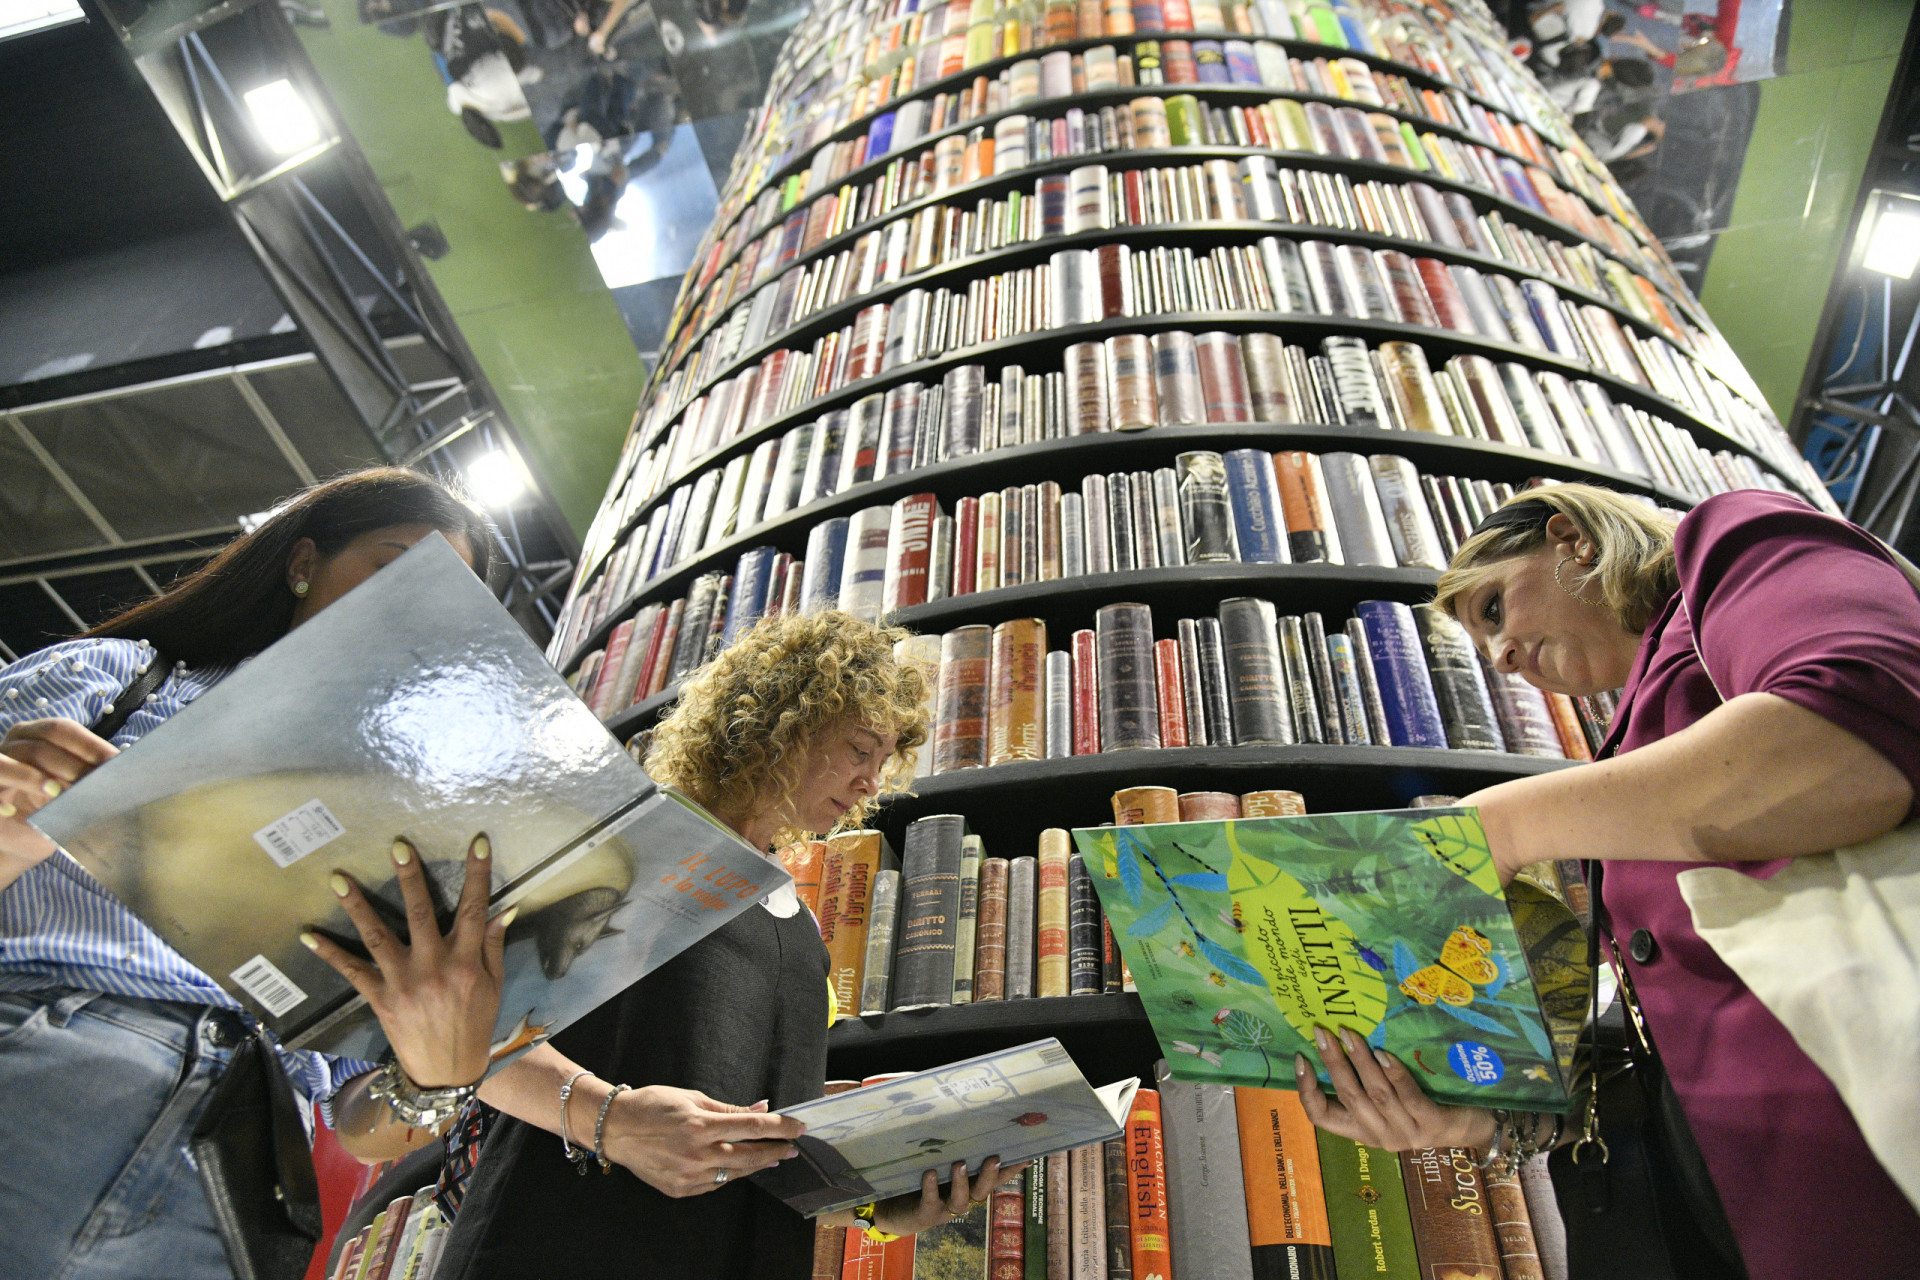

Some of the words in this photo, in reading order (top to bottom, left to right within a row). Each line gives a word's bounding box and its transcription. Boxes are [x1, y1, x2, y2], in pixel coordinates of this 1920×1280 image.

[1247, 491, 1267, 532] Cucchiaio
[1010, 723, 1037, 760] Harris
[679, 852, 710, 872] IL
[704, 866, 759, 899] LUPO
[673, 876, 695, 892] la
[690, 888, 729, 911] volpe
[840, 862, 868, 926] d'arancia
[905, 929, 943, 940] CANONICO
[907, 915, 946, 929] DIRITTO
[1263, 905, 1290, 960] mondo
[1257, 924, 1287, 982] piccolo
[1288, 906, 1358, 1017] INSETTI
[1292, 947, 1307, 978] degli
[836, 967, 856, 1011] Harris
[1289, 964, 1316, 1019] grande
[1455, 1043, 1476, 1082] Occasione
[1477, 1046, 1498, 1081] 50%
[1195, 1092, 1204, 1123] MEMORIE
[1270, 1108, 1280, 1131] FINANZA
[1273, 1131, 1282, 1147] DELLA
[1079, 1149, 1088, 1193] Persecuzioni
[1130, 1126, 1158, 1219] English
[1153, 1127, 1167, 1220] MACMILLAN
[1275, 1153, 1285, 1172] BANCA
[1358, 1148, 1370, 1172] Drago
[1360, 1173, 1370, 1181] Il
[1439, 1154, 1451, 1166] del
[1278, 1172, 1287, 1190] DELLA
[1450, 1145, 1483, 1215] SUCCE
[1080, 1197, 1088, 1215] delle
[1280, 1192, 1294, 1239] DELL'ECONOMIA,
[1080, 1220, 1089, 1245] Critica
[1368, 1209, 1380, 1240] Jordan
[1081, 1249, 1090, 1273] Storia
[1287, 1245, 1300, 1280] DIZIONARIO
[1374, 1242, 1387, 1272] Robert
